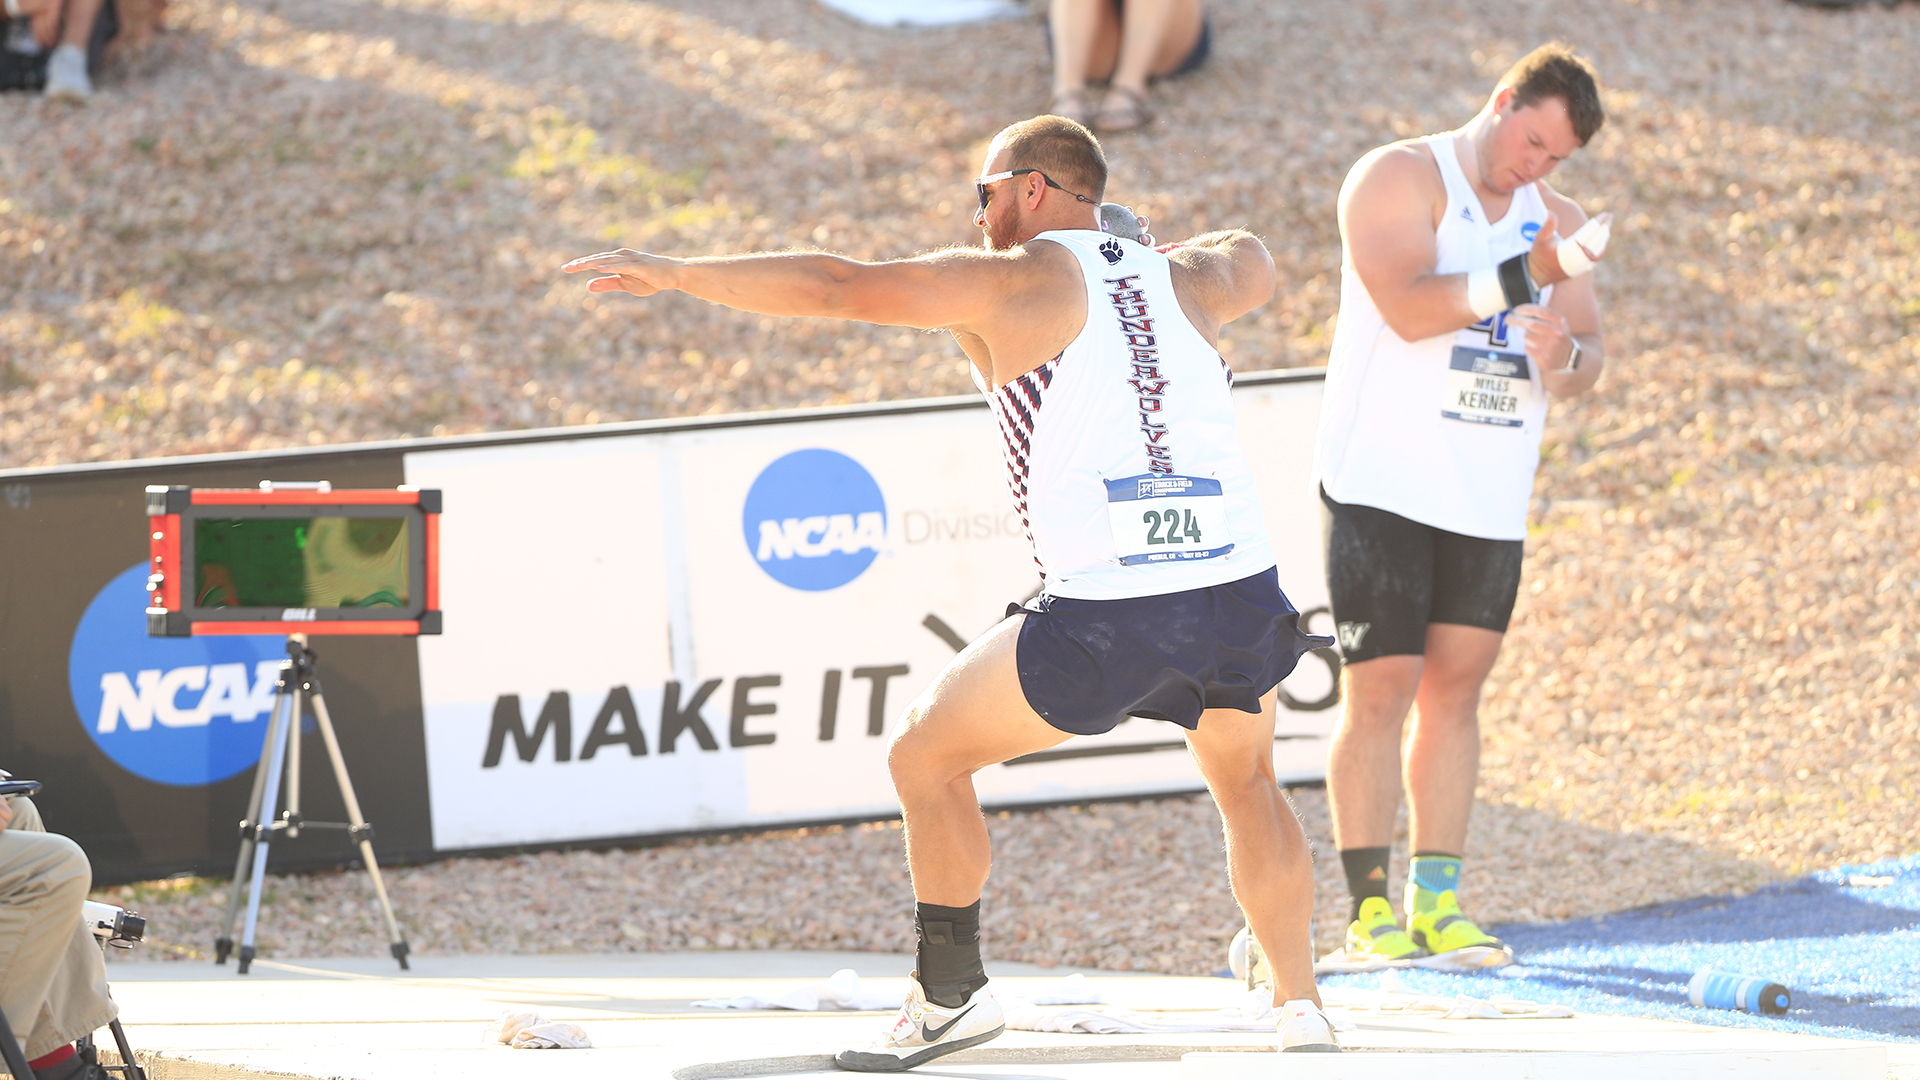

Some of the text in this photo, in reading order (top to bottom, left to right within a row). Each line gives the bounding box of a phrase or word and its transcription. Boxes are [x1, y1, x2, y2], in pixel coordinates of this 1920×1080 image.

[1102, 273, 1175, 475] THUNDERWOLVES
[1474, 377, 1510, 393] MYLES
[1458, 390, 1518, 413] KERNER
[756, 504, 1024, 561] NCAA Divisio
[1143, 508, 1201, 545] 224
[481, 664, 910, 769] MAKE IT
